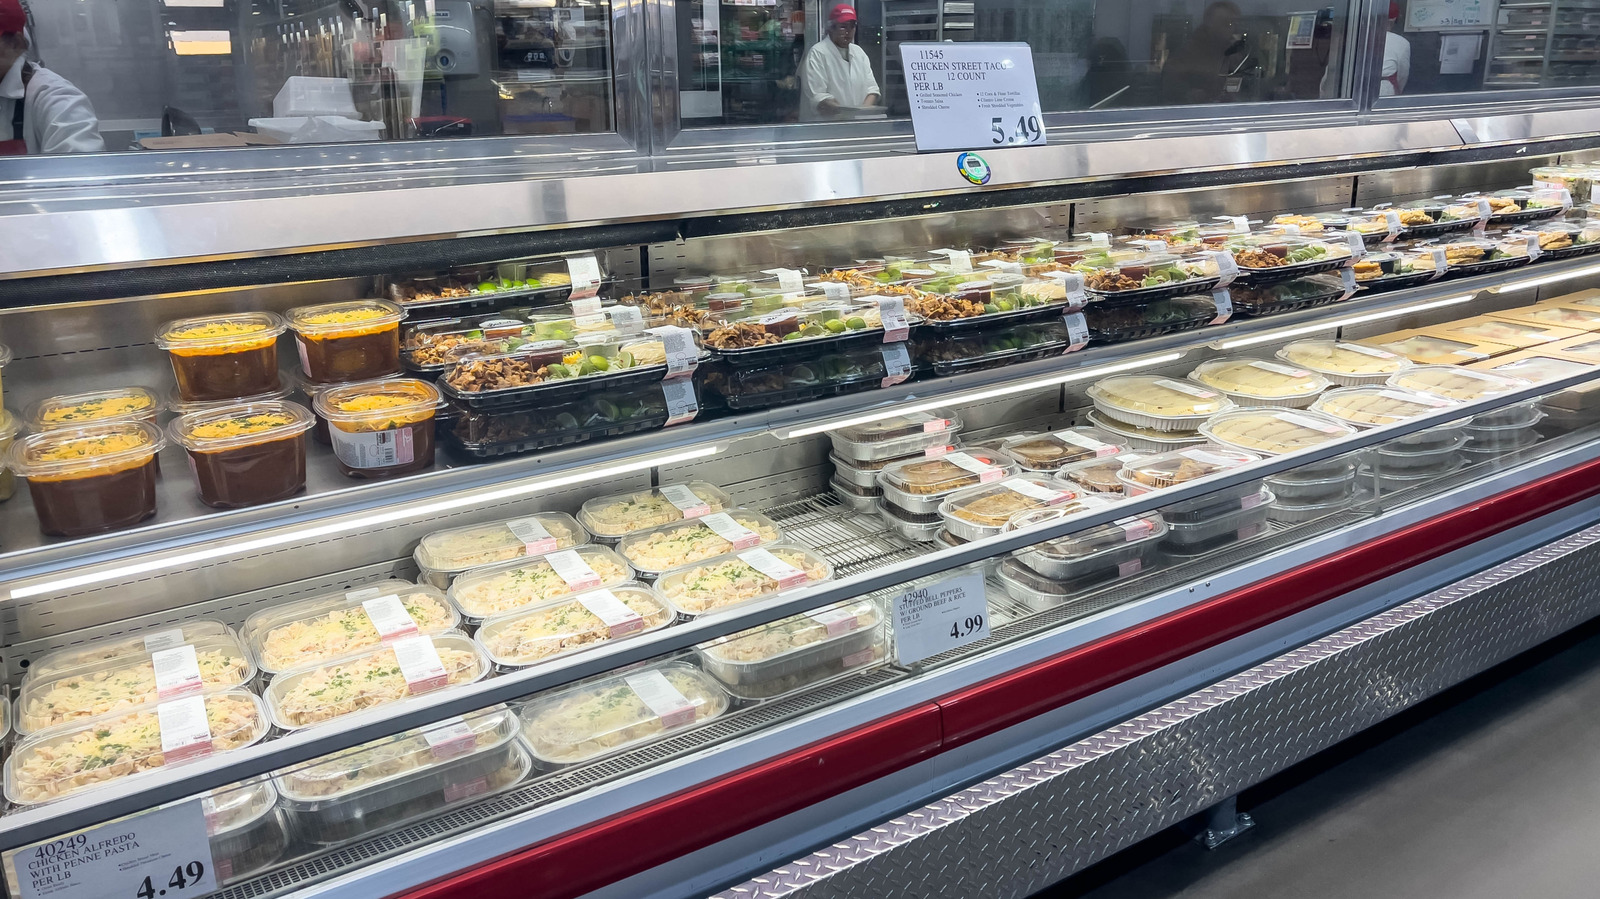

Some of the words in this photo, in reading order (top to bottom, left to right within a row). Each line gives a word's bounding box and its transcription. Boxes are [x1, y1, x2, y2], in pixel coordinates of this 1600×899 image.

[920, 50, 944, 60] 11545
[910, 62, 950, 70] CHICKEN
[952, 62, 982, 70] STREET
[912, 72, 926, 80] KIT
[948, 72, 956, 80] 12
[957, 72, 986, 80] COUNT
[914, 82, 930, 90] PER
[932, 82, 944, 90] LB
[992, 116, 1041, 144] 5.49
[902, 588, 928, 602] 42940
[940, 587, 962, 598] PEPPERS
[908, 602, 932, 614] GROUND
[934, 598, 947, 607] BEEF
[954, 592, 966, 601] RICE
[901, 616, 911, 624] PER
[950, 614, 983, 638] 4.99
[28, 848, 80, 870] CHICKEN
[84, 832, 136, 854] ALFREDO
[34, 834, 87, 858] 40249
[30, 864, 60, 879] WITH
[64, 852, 101, 869] PENNE
[105, 841, 140, 857] PASTA
[32, 876, 54, 888] PER
[57, 871, 71, 881] LB
[137, 860, 204, 899] 4.49
